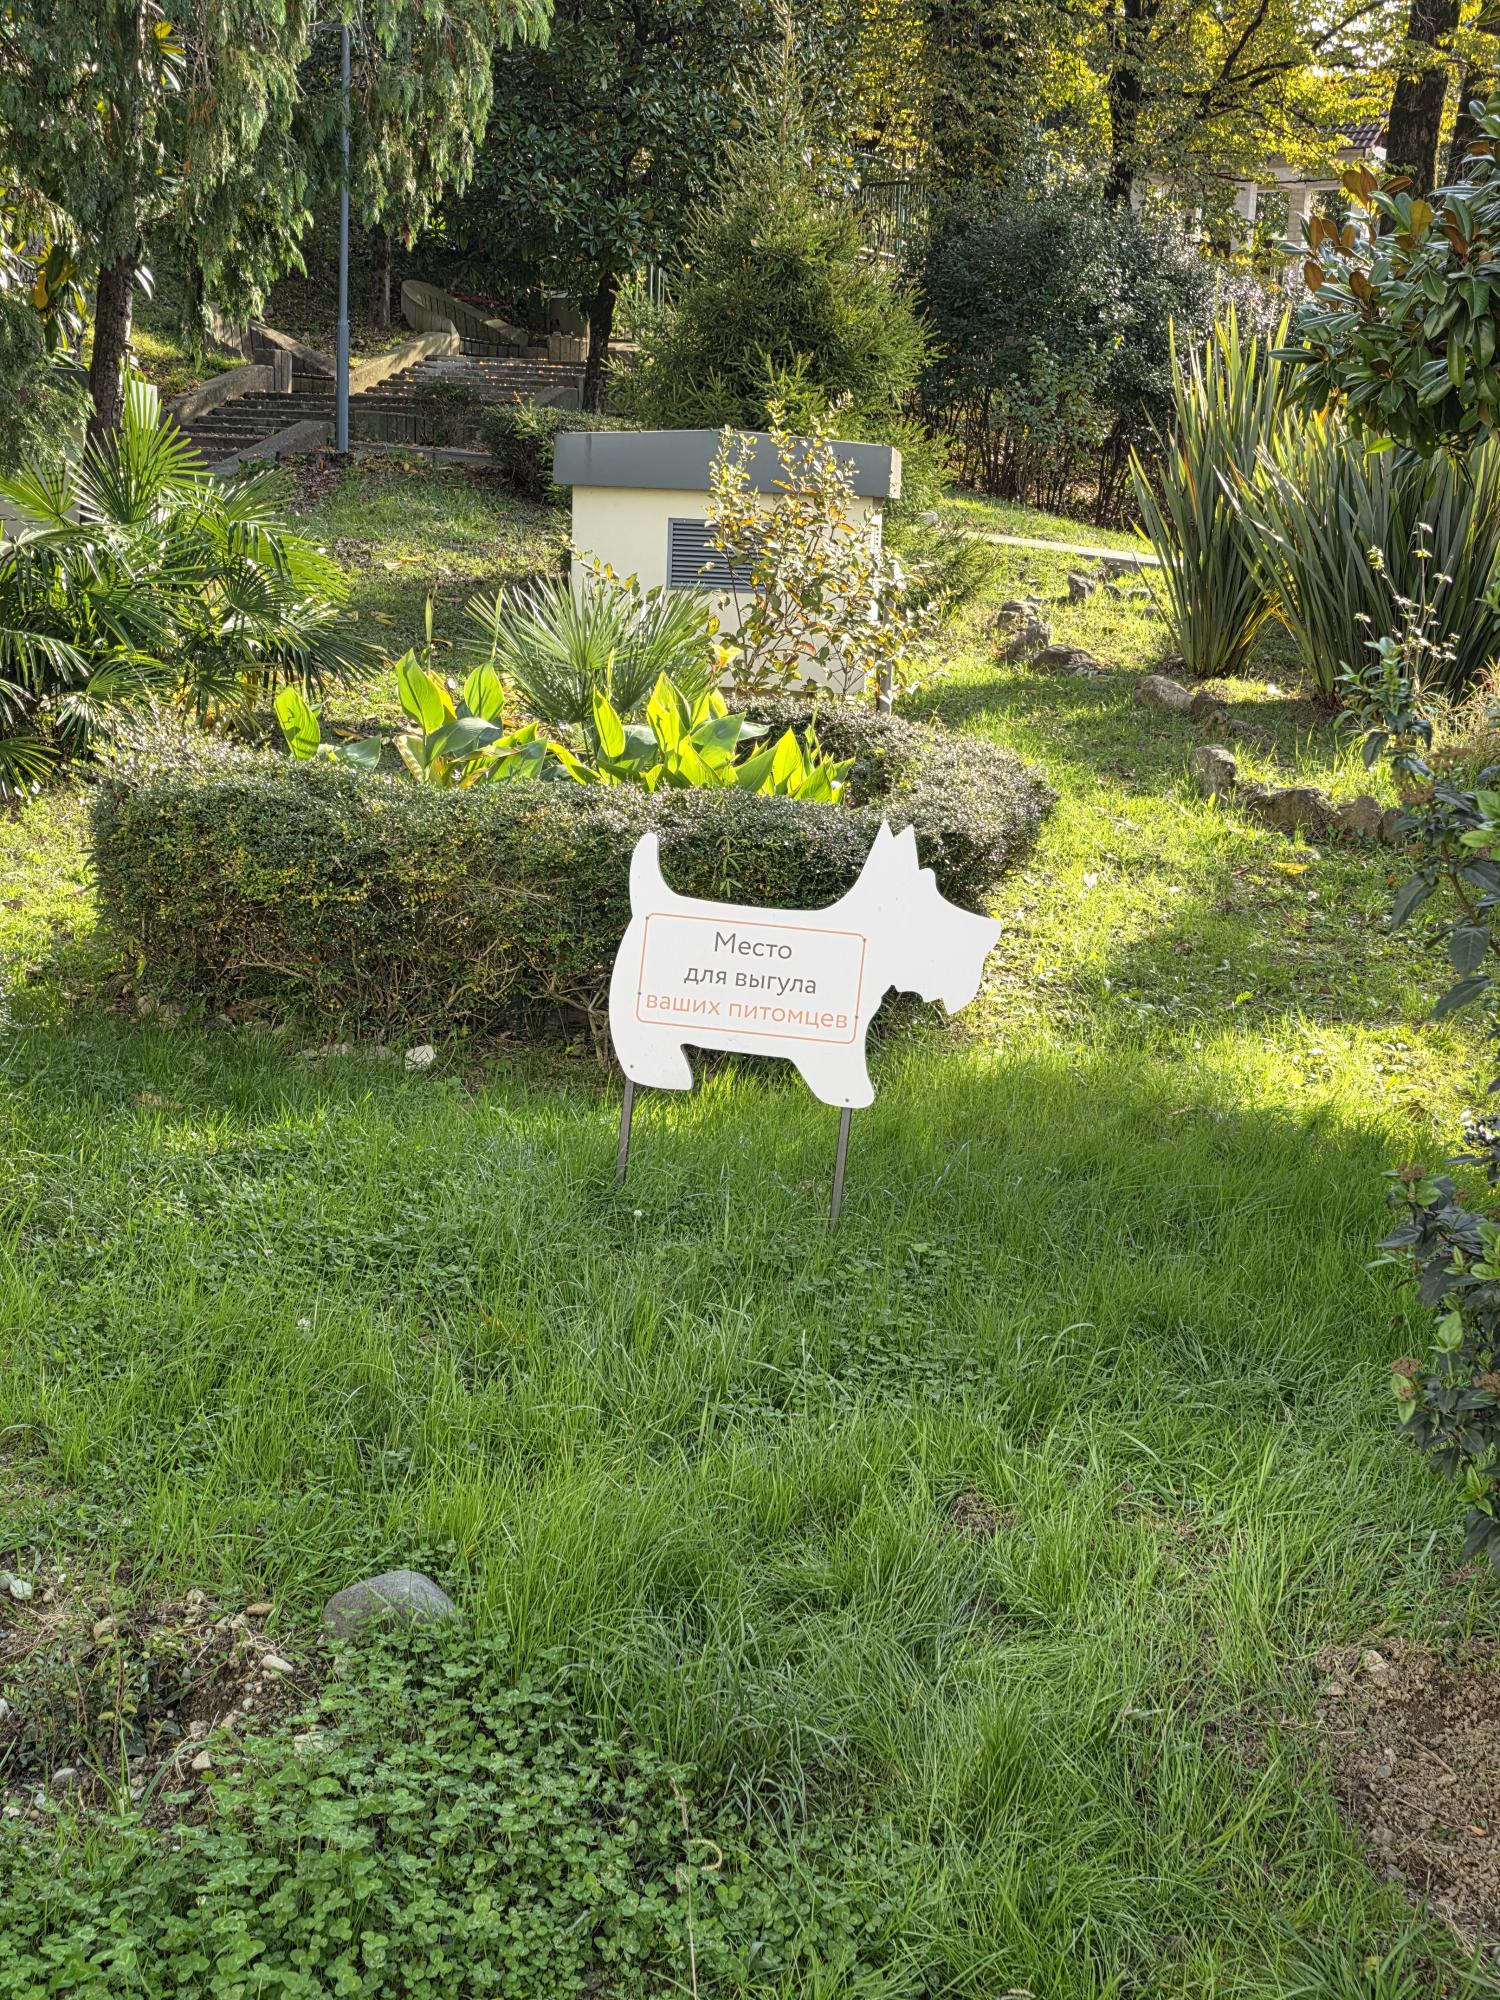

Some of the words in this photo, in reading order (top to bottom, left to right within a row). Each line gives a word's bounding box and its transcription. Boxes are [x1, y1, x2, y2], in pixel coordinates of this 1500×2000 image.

[714, 931, 793, 960] Место
[683, 967, 727, 985] для
[735, 972, 817, 997] выгула
[646, 993, 720, 1016] ваших
[728, 1002, 848, 1029] питомцев
